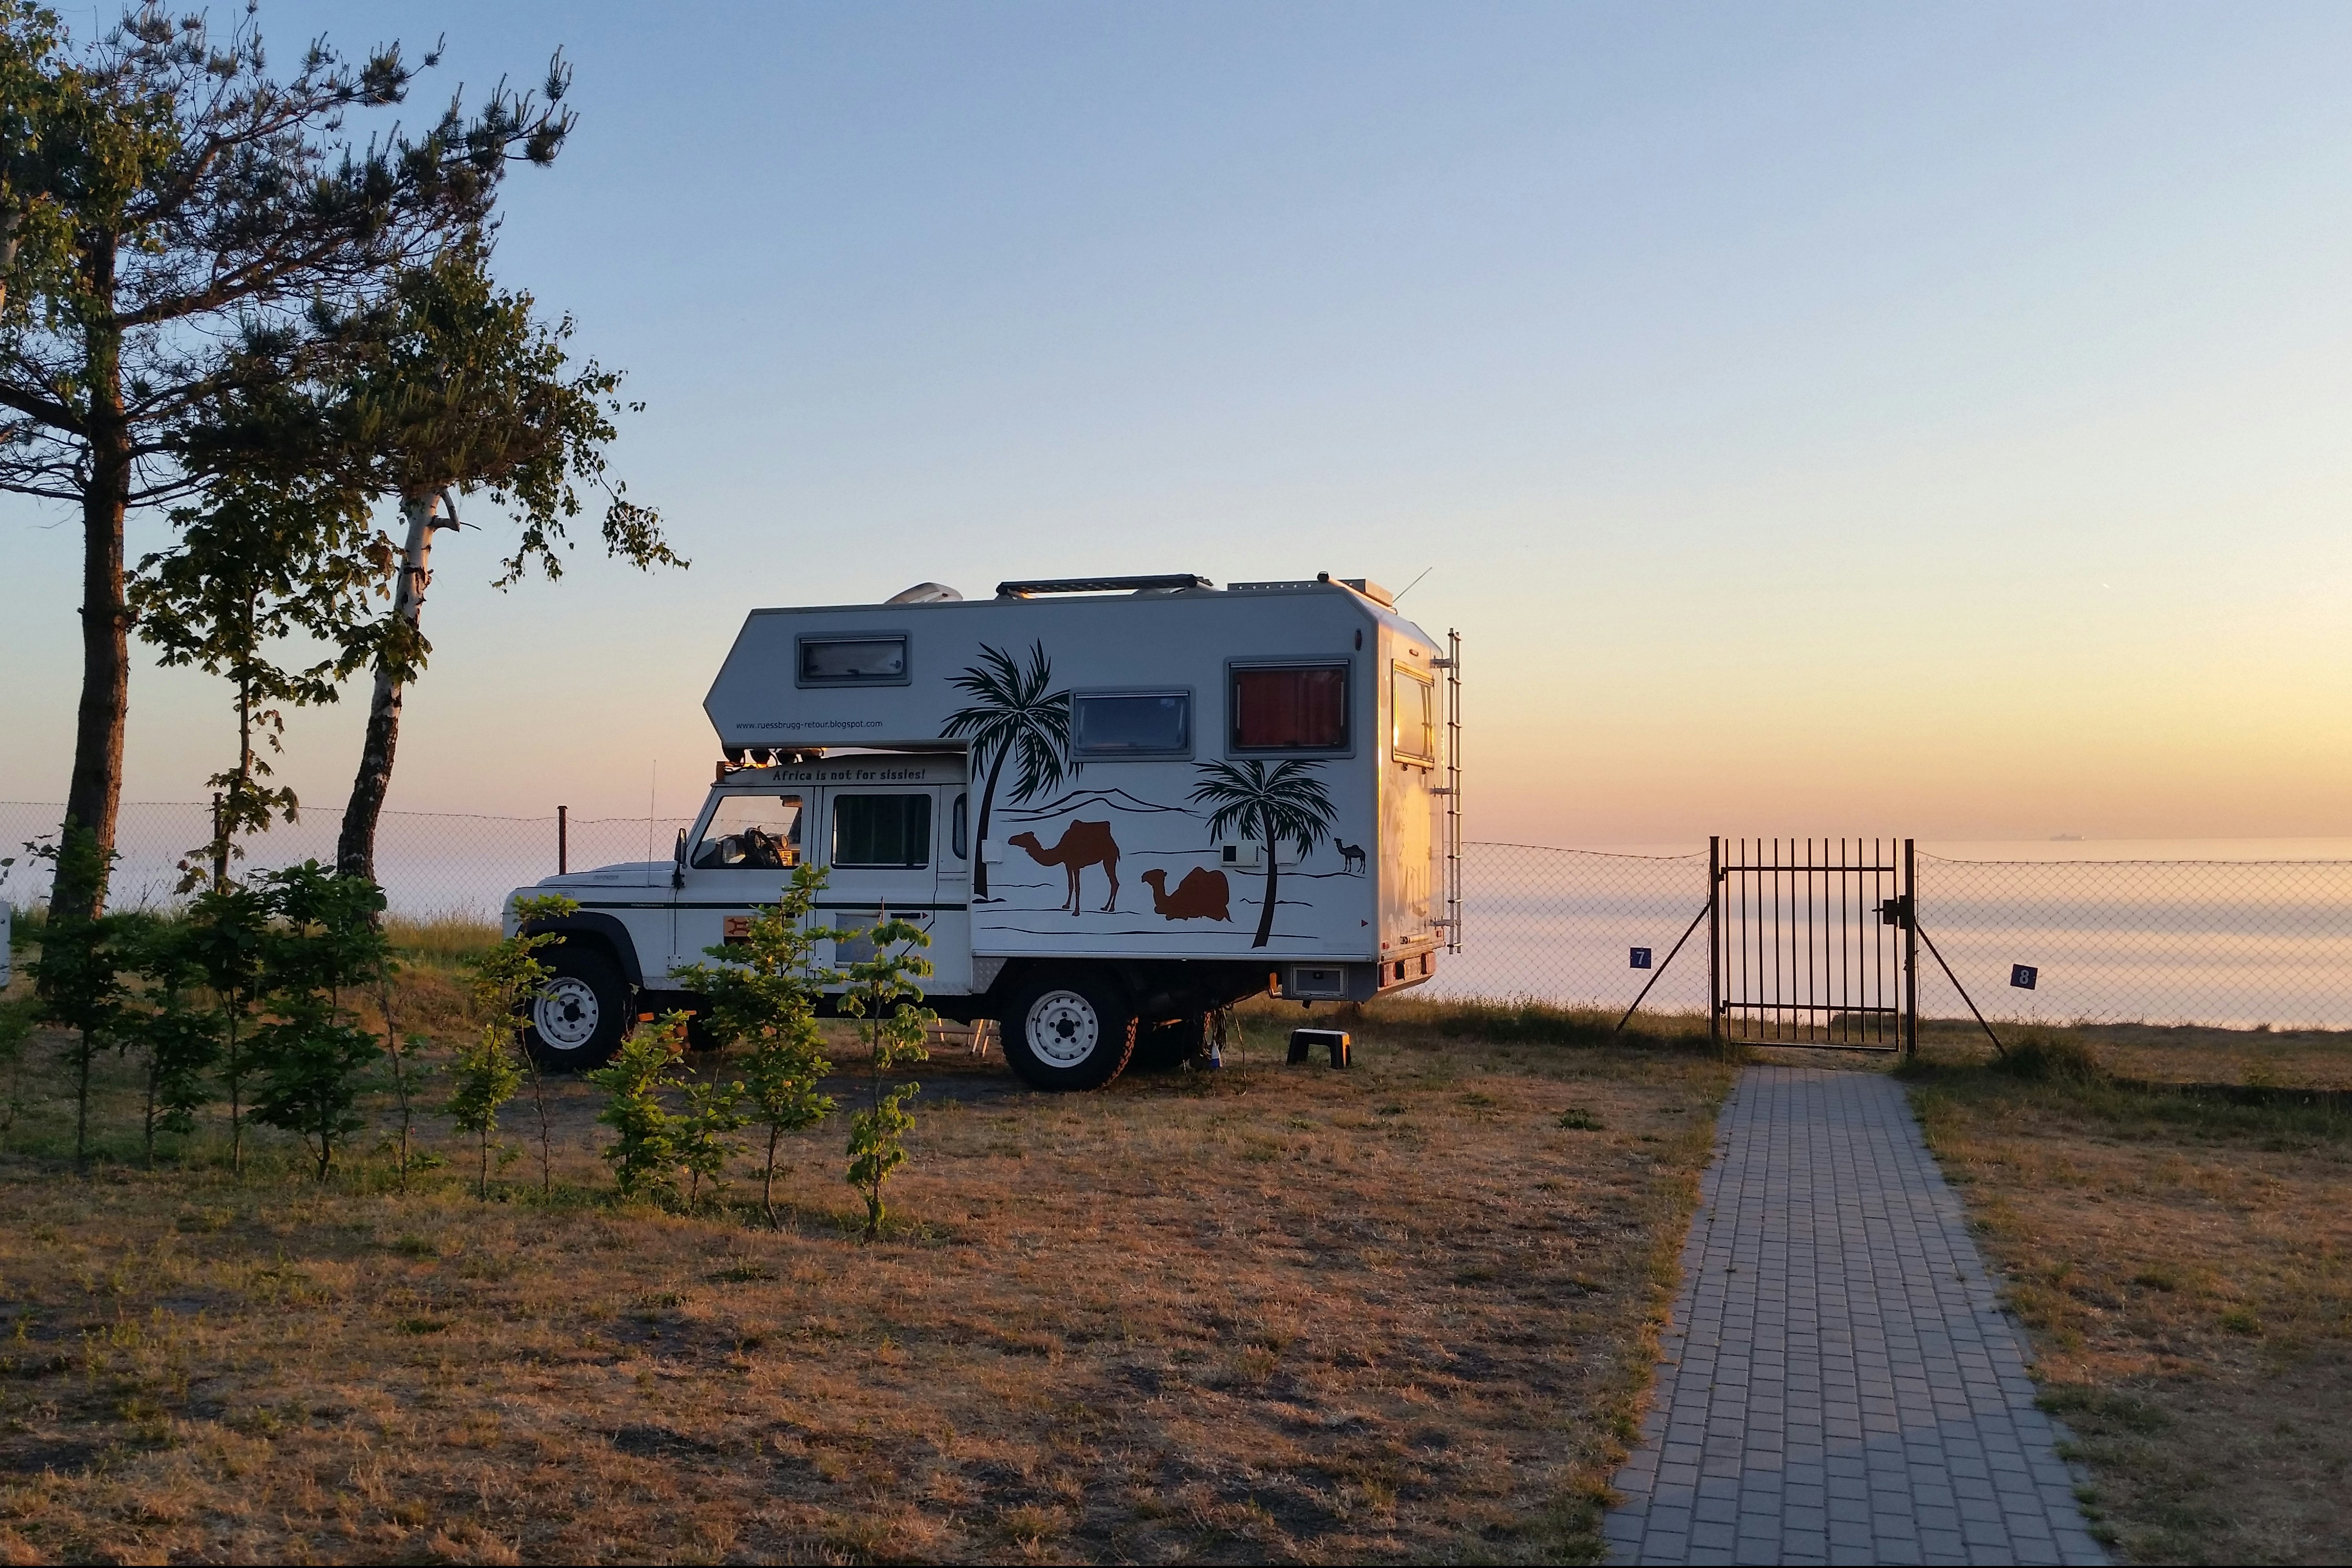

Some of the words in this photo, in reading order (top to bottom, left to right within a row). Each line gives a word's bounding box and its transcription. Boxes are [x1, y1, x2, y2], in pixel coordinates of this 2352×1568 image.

[736, 720, 883, 730] www.ruessbrugg-retour.blogspot.com
[772, 770, 812, 780] Africa
[816, 770, 827, 780] is
[830, 770, 852, 780] not
[855, 769, 876, 780] for
[880, 769, 926, 780] sissies!
[1636, 951, 1645, 965] 7
[2019, 970, 2029, 984] 8
